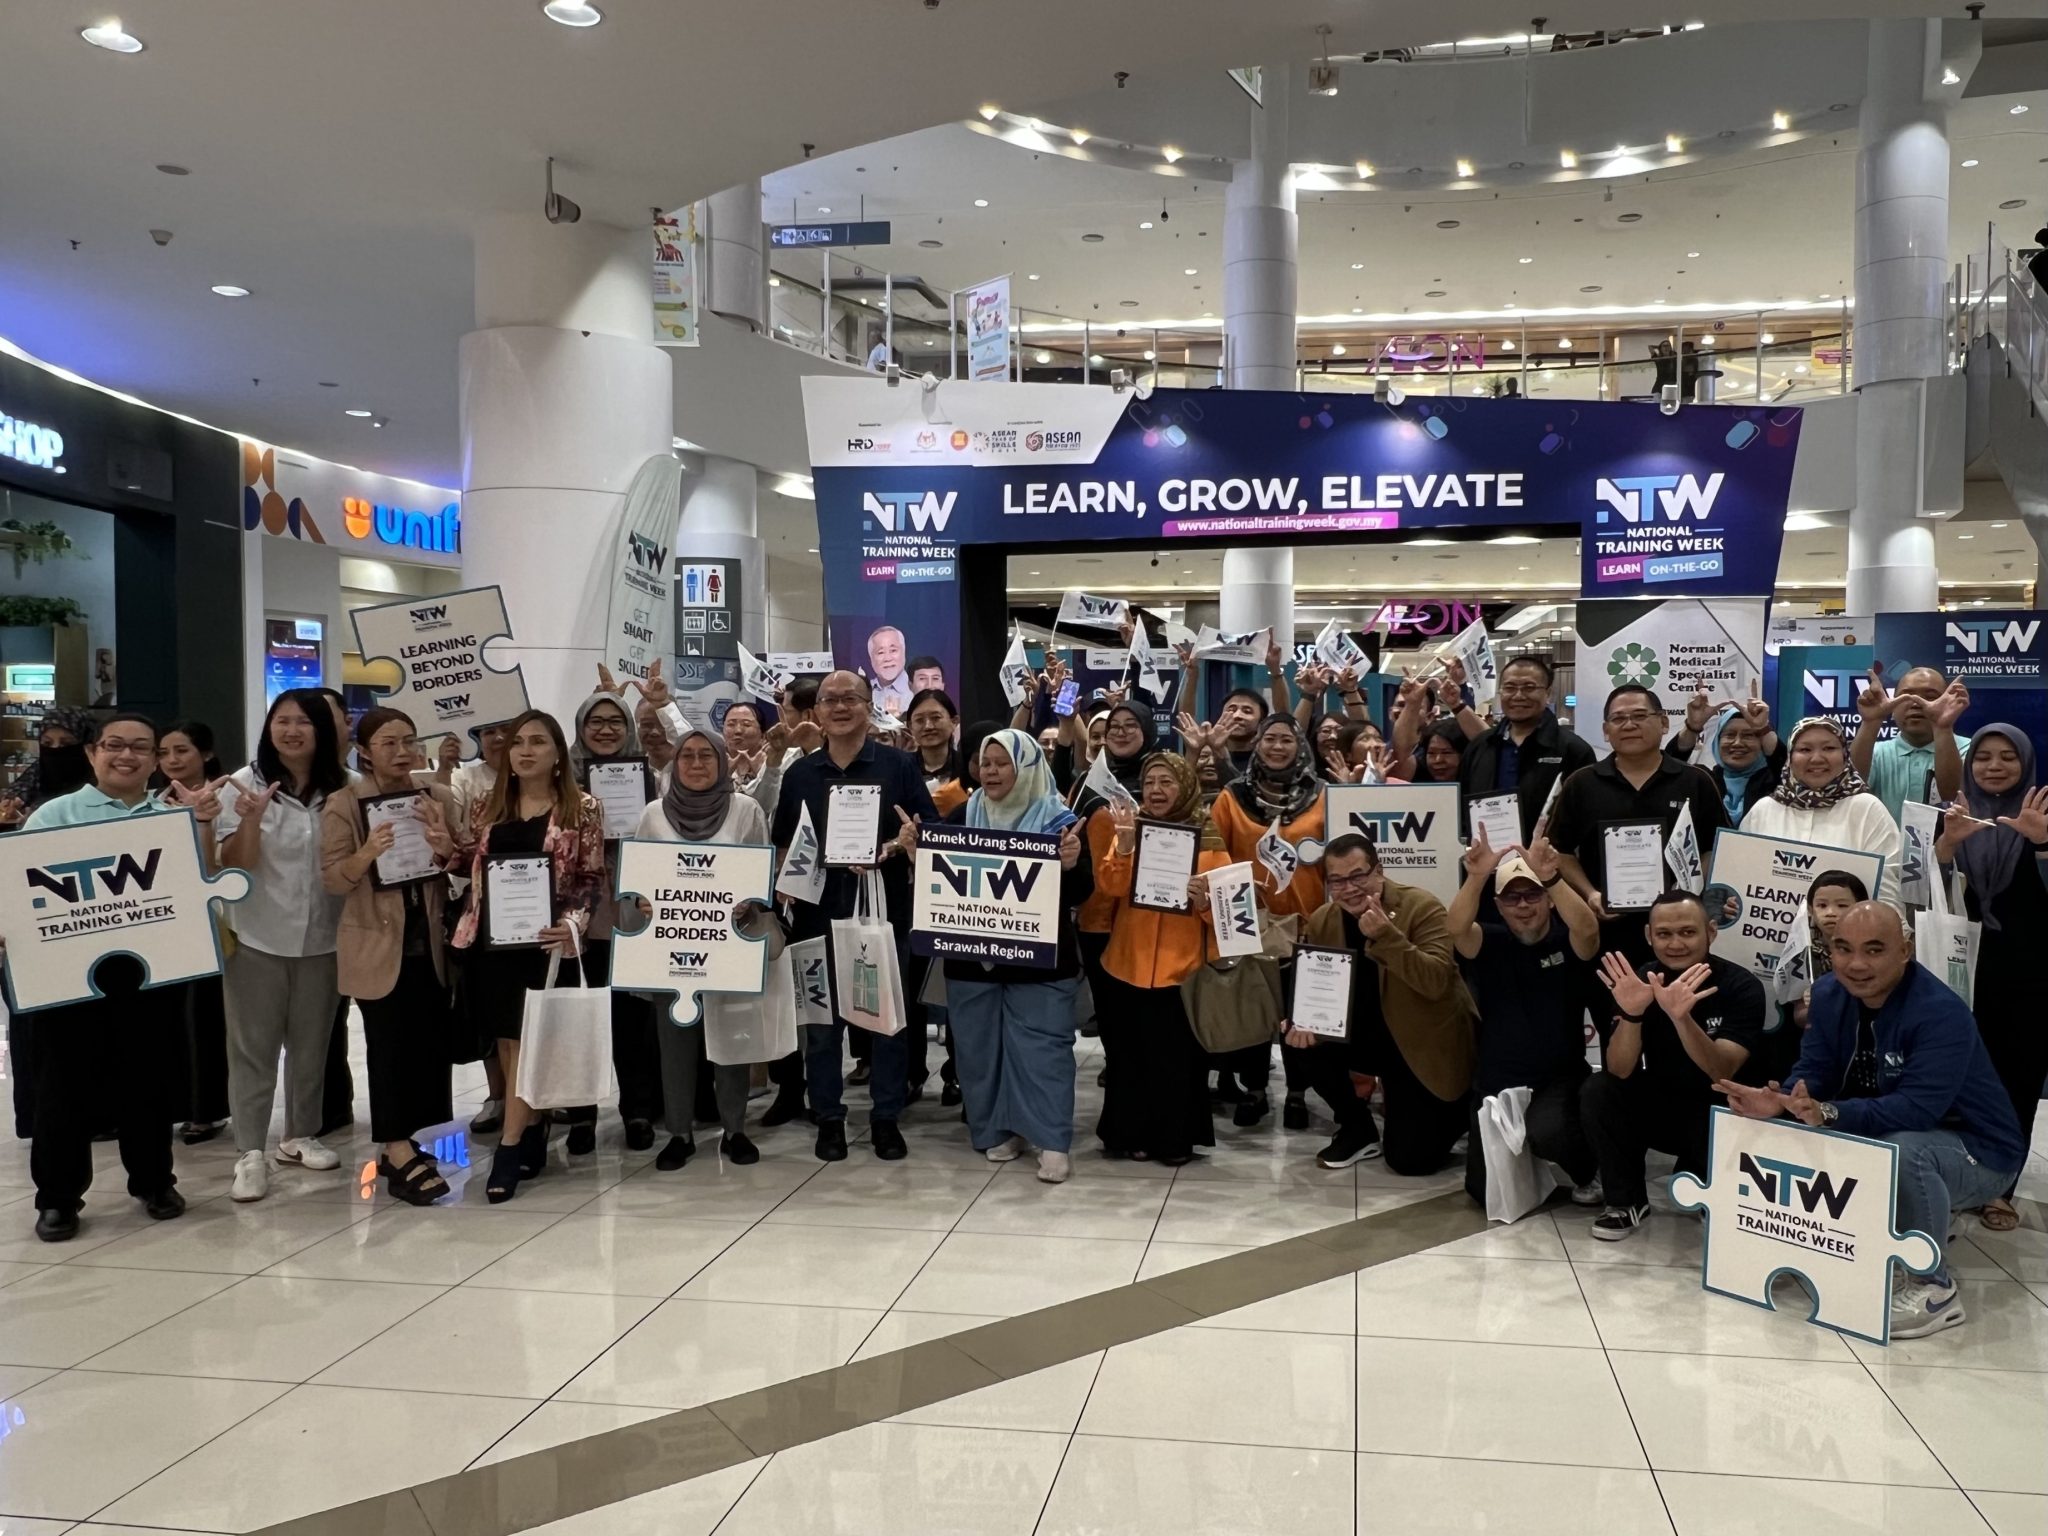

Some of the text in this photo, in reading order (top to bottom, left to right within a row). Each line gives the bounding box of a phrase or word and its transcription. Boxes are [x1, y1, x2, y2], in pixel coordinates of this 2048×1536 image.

[1045, 432, 1081, 443] ASEAN
[1003, 473, 1524, 519] LEARN, GROW, ELEVATE
[1596, 472, 1726, 523] NTW
[863, 491, 958, 531] NTW
[374, 503, 461, 554] unif
[1177, 515, 1383, 533] www.nationaltrainingweek.gov.my
[1626, 525, 1692, 538] NATIONAL
[885, 536, 932, 545] NATIONAL
[1596, 538, 1723, 554] TRAINING WEEK
[863, 546, 956, 558] TRAINING WEEK
[867, 566, 952, 578] LEARN ON-THE-GO
[1602, 559, 1719, 576] LEARN ON-THE-GO
[409, 604, 447, 623] NTW
[1079, 595, 1119, 616] NTW
[400, 634, 477, 659] LEARNING
[1946, 620, 2041, 653] NTW
[1669, 644, 1726, 654] Normah
[411, 653, 475, 675] BEYOND
[1669, 656, 1722, 666] Medical
[1945, 664, 2040, 675] TRAINING WEEK
[1968, 656, 2017, 664] NATIONAL
[412, 669, 482, 692] BORDERS
[1669, 669, 1737, 681] Specialist
[434, 693, 471, 713] NTW
[1349, 811, 1436, 843] NTW
[922, 830, 1057, 855] Kamek Urang Sokong
[677, 853, 716, 868] NTW
[1405, 856, 1437, 864] WEEK
[1773, 849, 1817, 870] NTW
[26, 848, 163, 909] NTW
[931, 853, 1044, 903] NTW
[655, 888, 733, 904] LEARNING
[70, 899, 140, 918] NATIONAL
[660, 907, 725, 923] BEYOND
[957, 903, 1013, 916] NATIONAL
[1231, 882, 1257, 937] NTW
[1749, 905, 1795, 925] BEYO
[38, 904, 175, 937] TRAINING WEEK
[930, 912, 1040, 933] TRAINING WEEK
[655, 926, 728, 941] BORDERS
[1742, 923, 1789, 944] BORD
[934, 938, 1034, 959] Sarawak Region
[670, 951, 709, 967] NTW
[1755, 951, 1780, 970] NT
[804, 958, 828, 1010] NTW
[1738, 1152, 1858, 1220] NTW
[1765, 1208, 1825, 1232] NATIONAL
[1737, 1213, 1855, 1257] TRAINING WEEK
